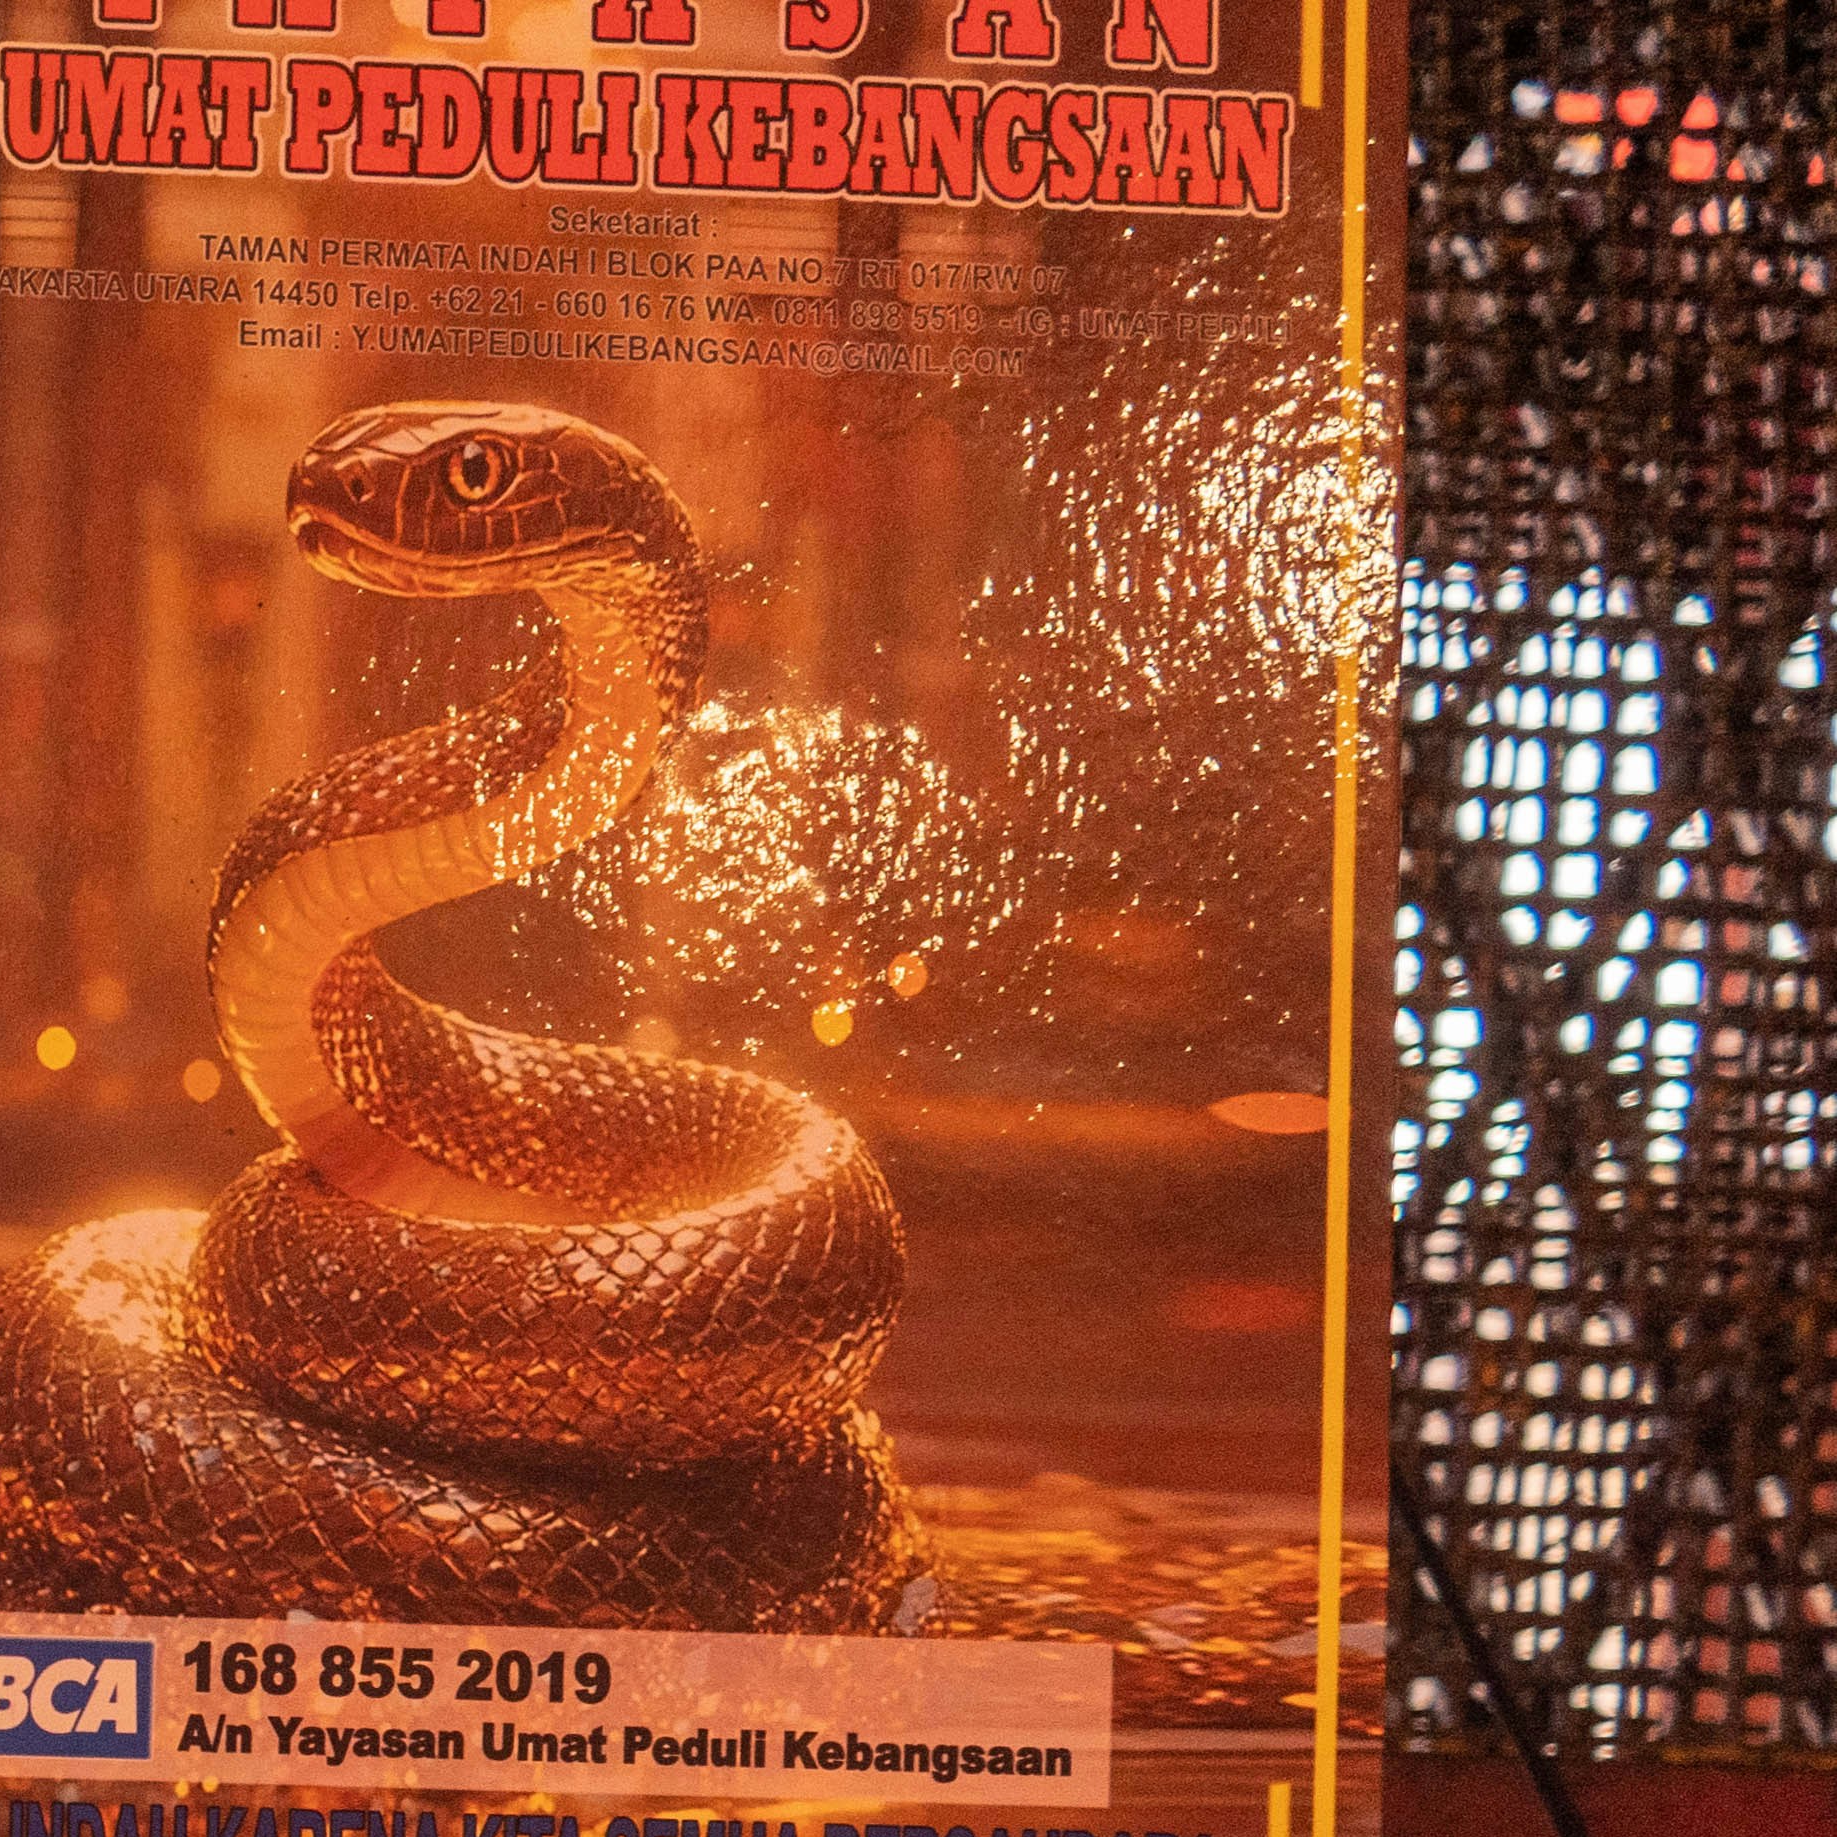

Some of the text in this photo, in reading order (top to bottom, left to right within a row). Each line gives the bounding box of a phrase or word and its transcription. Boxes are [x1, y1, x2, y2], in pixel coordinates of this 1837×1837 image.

[0, 48, 1287, 212] UMAT PEDULI KEBANGSAAN
[551, 205, 700, 238] Seketariat
[199, 234, 309, 264] TAMAN
[320, 239, 470, 270] PERMATA
[480, 246, 578, 275] INDAH
[608, 251, 695, 279] BLOK
[705, 254, 769, 283] PAA
[778, 258, 850, 286] NO.7
[860, 259, 901, 288] RT
[911, 262, 1022, 292] 017/RW
[1033, 266, 1068, 295] 07
[135, 273, 242, 303] UTARA
[252, 279, 337, 307] 14450
[350, 282, 418, 315] Telp.
[430, 286, 481, 314] +62
[490, 291, 523, 315] 21
[556, 291, 607, 318] 660
[621, 294, 651, 320] 16
[662, 296, 695, 320] 76
[774, 299, 840, 326] 0811
[851, 301, 903, 329] 898
[913, 305, 983, 333] 5519
[1080, 308, 1169, 340] UMAT
[1177, 313, 1292, 346] PEDULI
[239, 320, 322, 351] Email
[351, 323, 1025, 377] Y.UMATPEDULIKEBANGSAAN@GMAIL.COM
[183, 1640, 611, 1705] 168 855 2019
[177, 1713, 1072, 1783] A/n Yayasan Umat Peduli Kebangsaan
